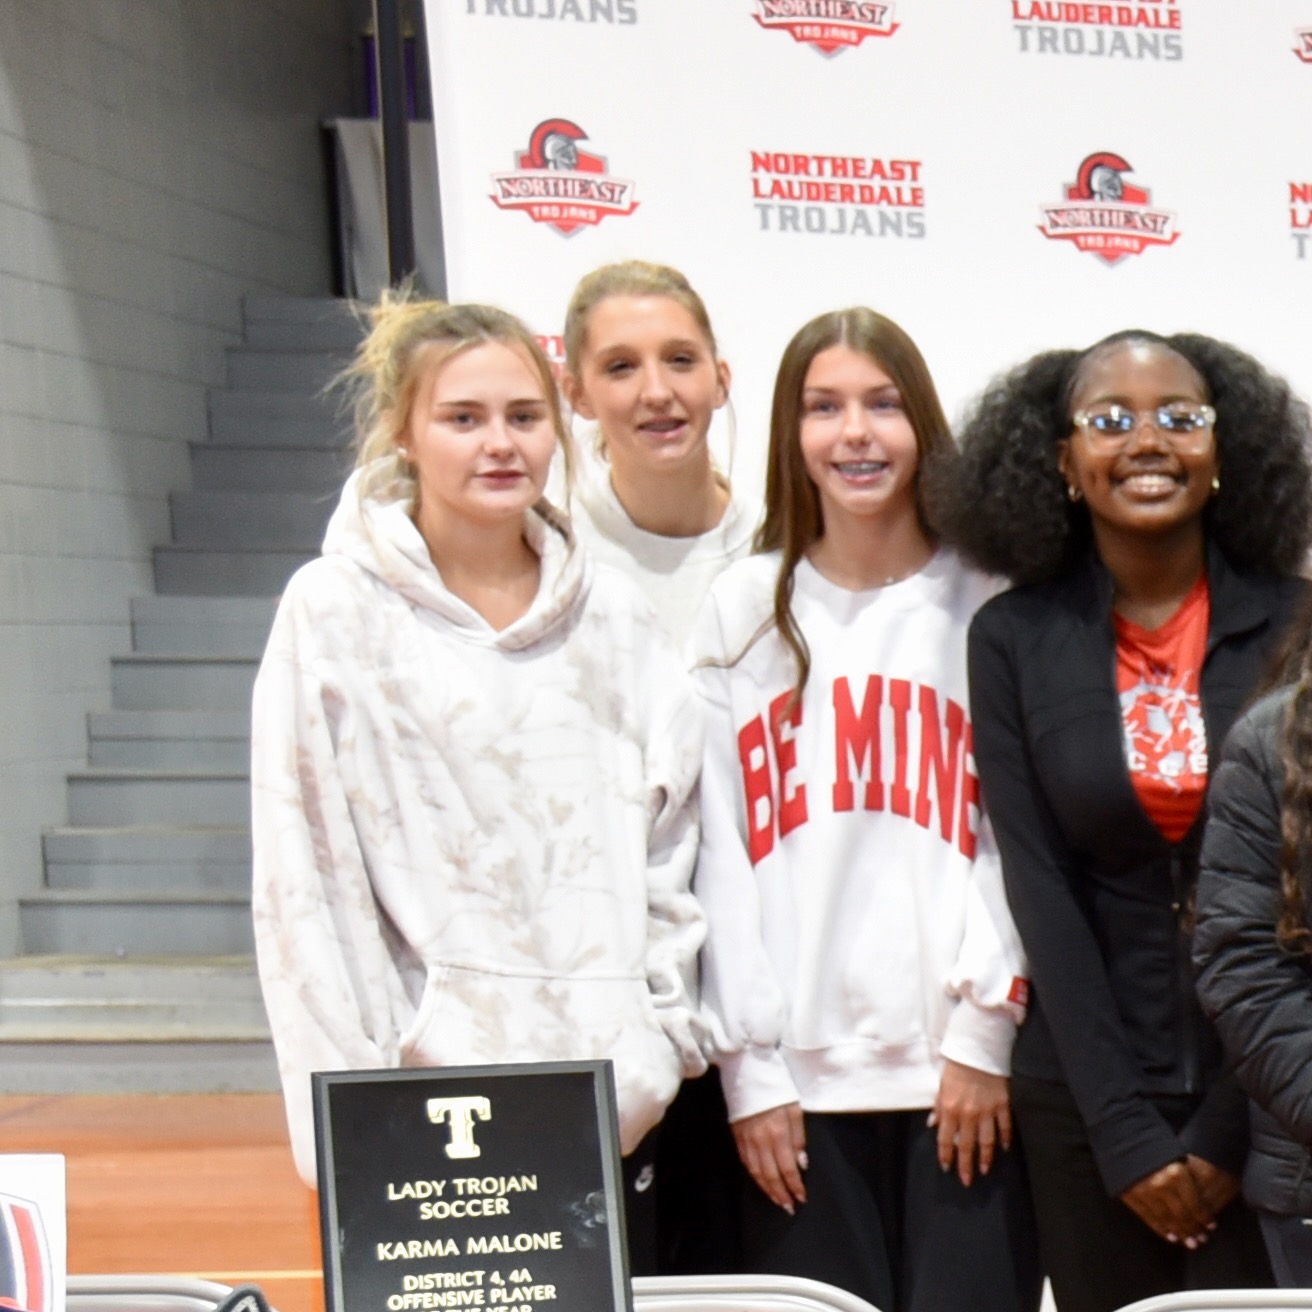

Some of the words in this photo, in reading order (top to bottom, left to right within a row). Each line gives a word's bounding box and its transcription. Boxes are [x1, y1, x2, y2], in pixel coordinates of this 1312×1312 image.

[1012, 2, 1182, 29] LAUDERDALE
[1014, 25, 1183, 61] TROJANS
[751, 150, 922, 182] NORTHEAST
[499, 177, 627, 206] NORTHEAST
[752, 178, 924, 208] LAUDERDALE
[754, 203, 926, 239] TROJANS
[1045, 207, 1169, 235] NORTHEAST
[738, 688, 809, 866] BE
[428, 1096, 491, 1159] T
[388, 1179, 446, 1200] LADY
[453, 1174, 538, 1196] TROJAN
[420, 1198, 510, 1219] SOCCER
[377, 1239, 459, 1261] KARMA
[467, 1231, 563, 1254] MALONE
[403, 1271, 485, 1291] DISTRICT
[509, 1268, 532, 1285] 4A
[387, 1289, 485, 1311] OFFENSIVE
[490, 1284, 557, 1304] PLAYER
